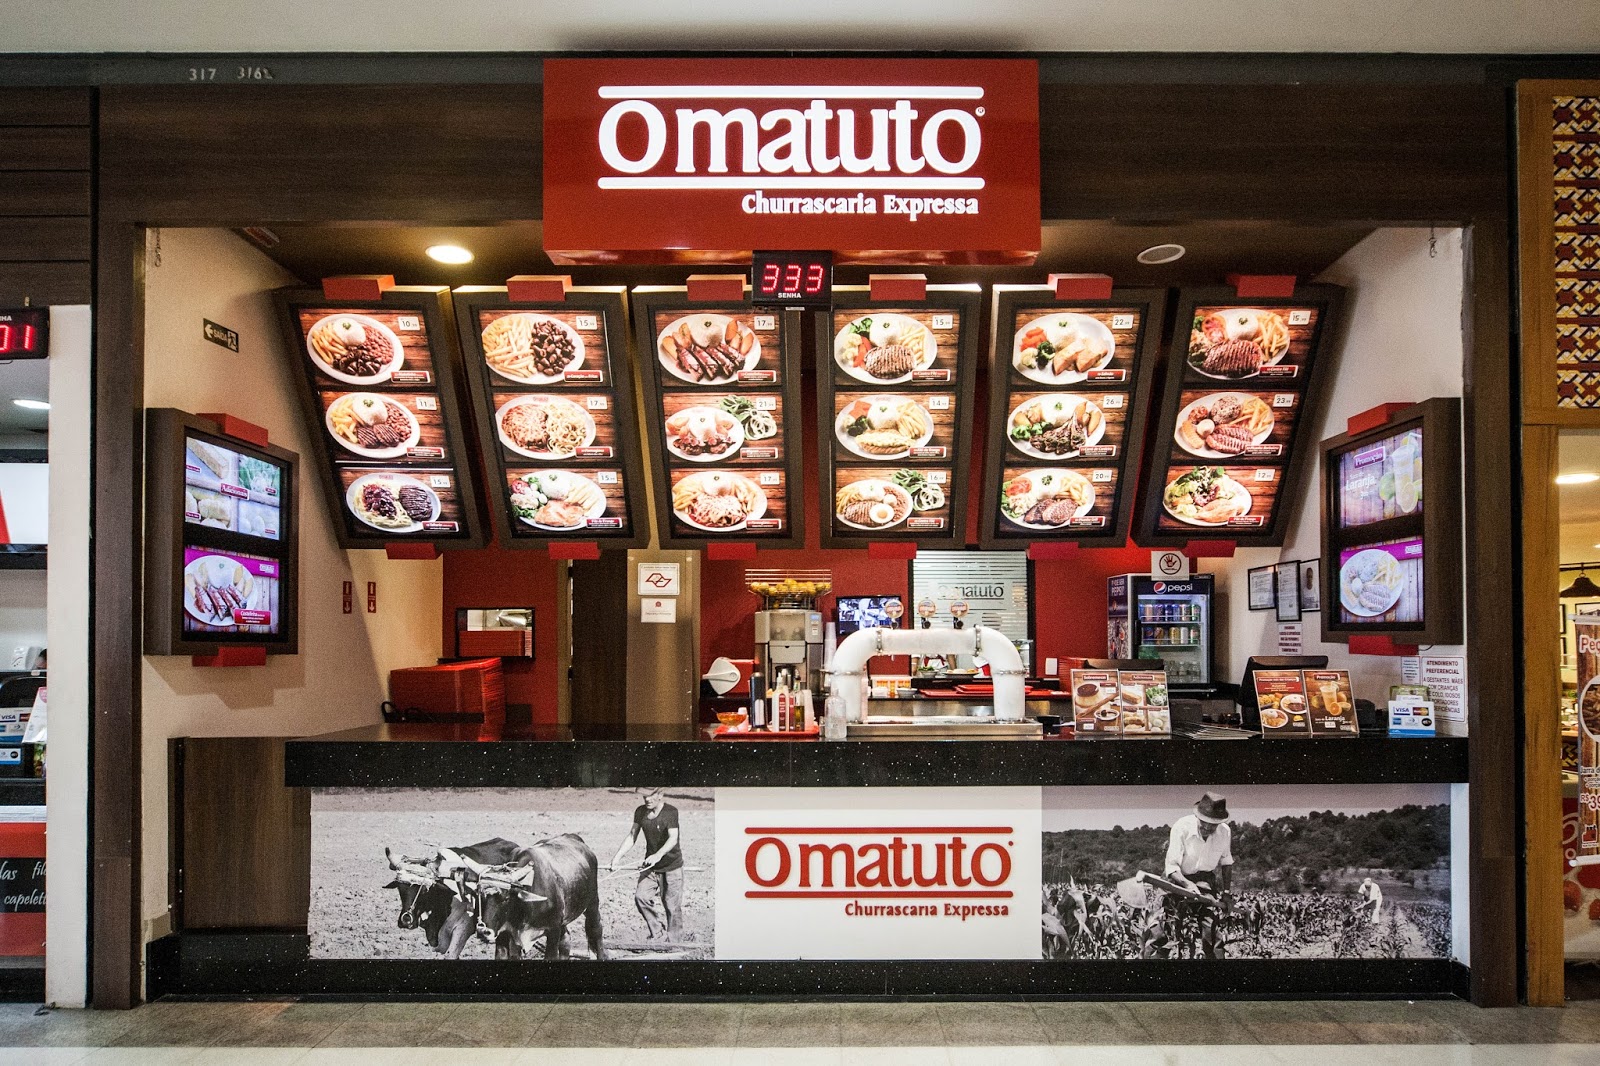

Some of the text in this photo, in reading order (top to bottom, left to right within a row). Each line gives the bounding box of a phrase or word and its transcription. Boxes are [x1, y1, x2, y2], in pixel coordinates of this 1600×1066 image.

[189, 68, 217, 80] 317
[742, 190, 979, 222] Churrascaria Expressa
[762, 264, 823, 292] 333
[1168, 583, 1193, 592] pepsi
[844, 901, 1009, 921] Churrascaria Expressa
